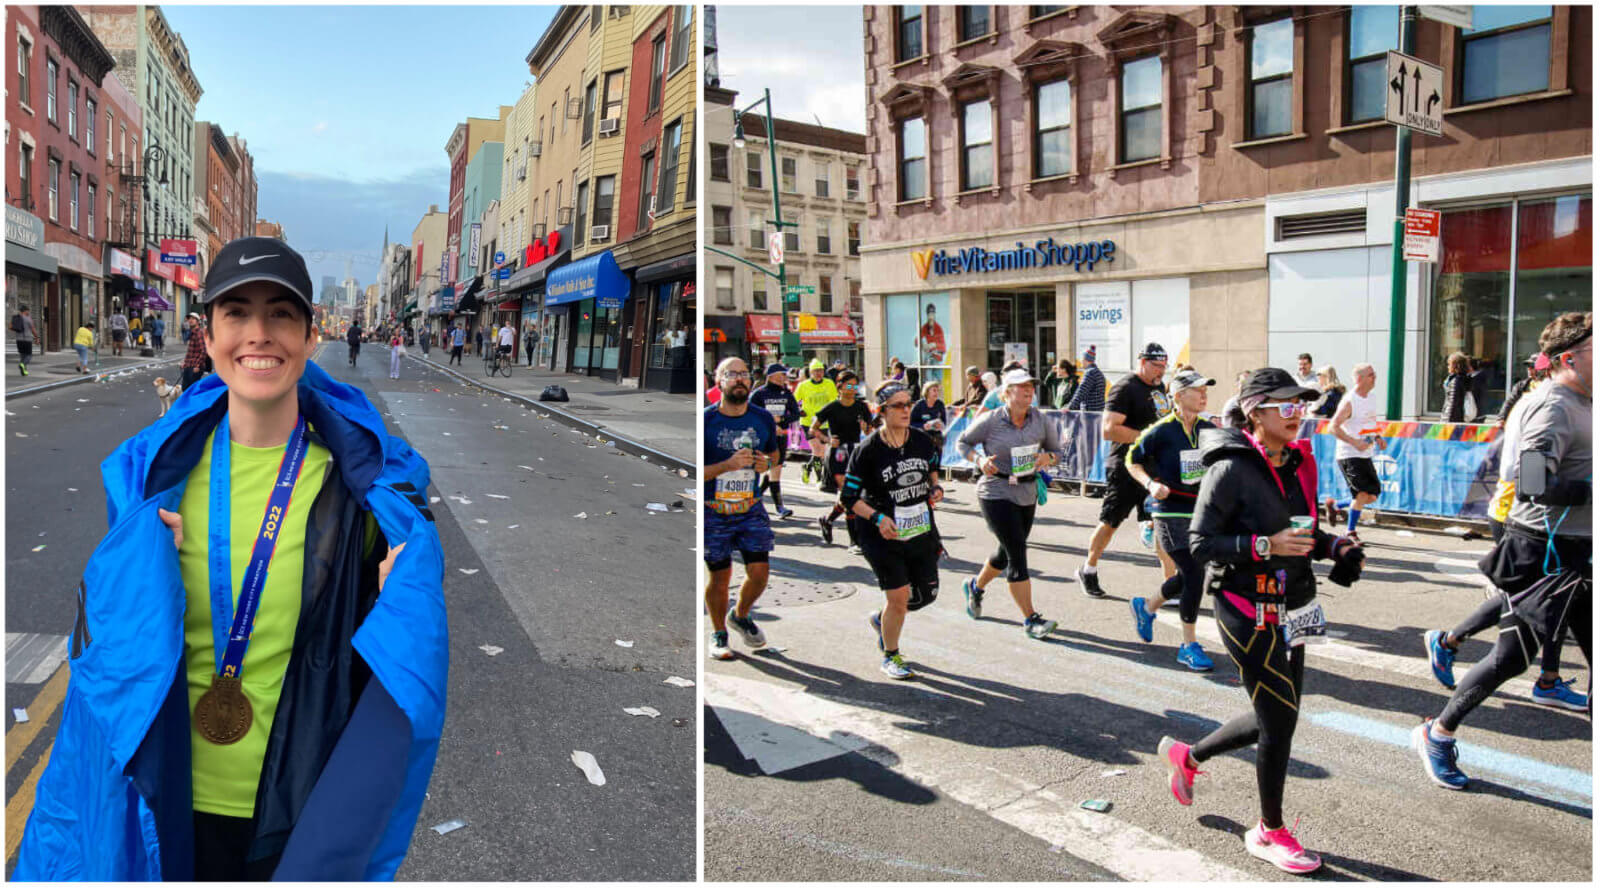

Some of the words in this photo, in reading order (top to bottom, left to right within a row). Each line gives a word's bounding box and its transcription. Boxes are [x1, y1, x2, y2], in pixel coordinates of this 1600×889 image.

[1408, 112, 1424, 126] ONLY
[1425, 116, 1441, 130] ONLY
[1080, 305, 1122, 324] savings
[882, 465, 896, 482] ST.
[264, 505, 282, 540] 2022
